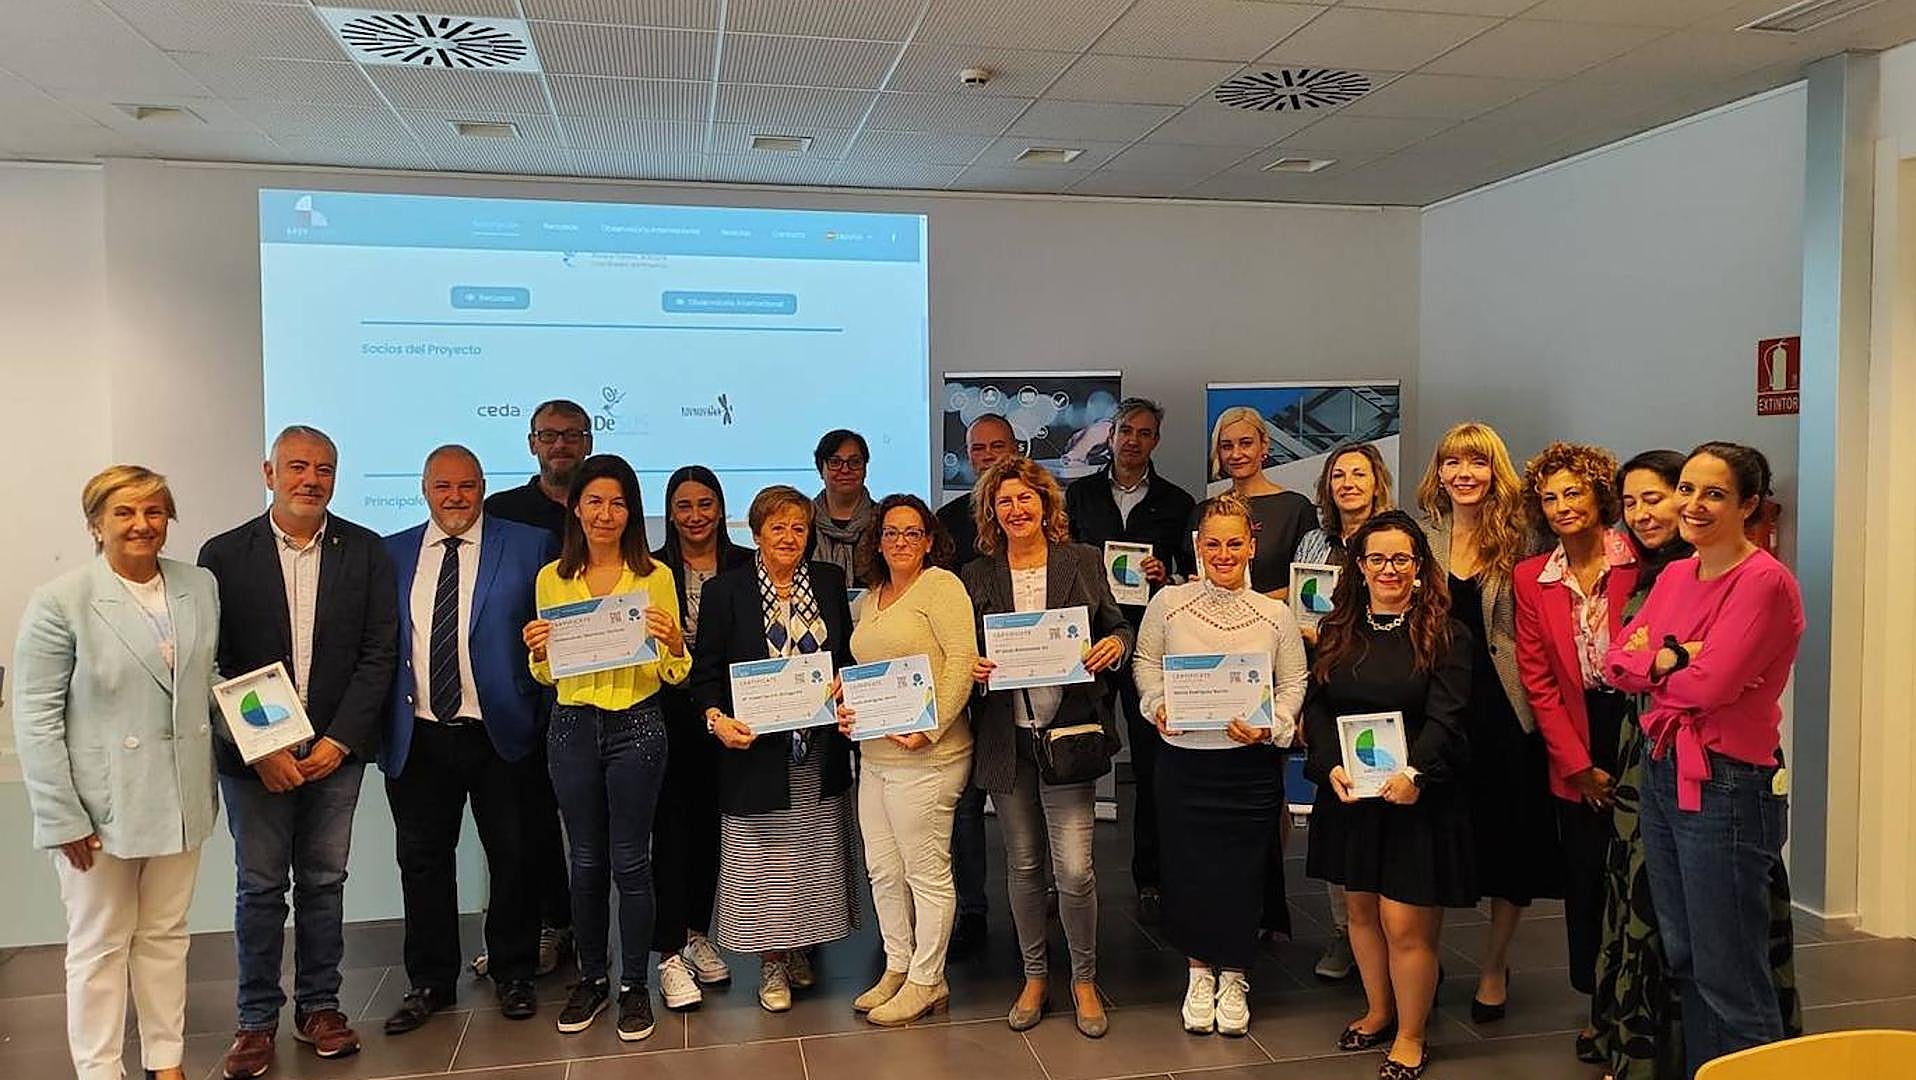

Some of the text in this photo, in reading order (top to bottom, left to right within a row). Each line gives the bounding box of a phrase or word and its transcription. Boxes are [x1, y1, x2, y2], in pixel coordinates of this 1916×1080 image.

[361, 343, 482, 358] Socios del Proyecto
[477, 403, 521, 417] ceda
[1758, 397, 1798, 412] EXTINTOR
[364, 495, 425, 510] Principale
